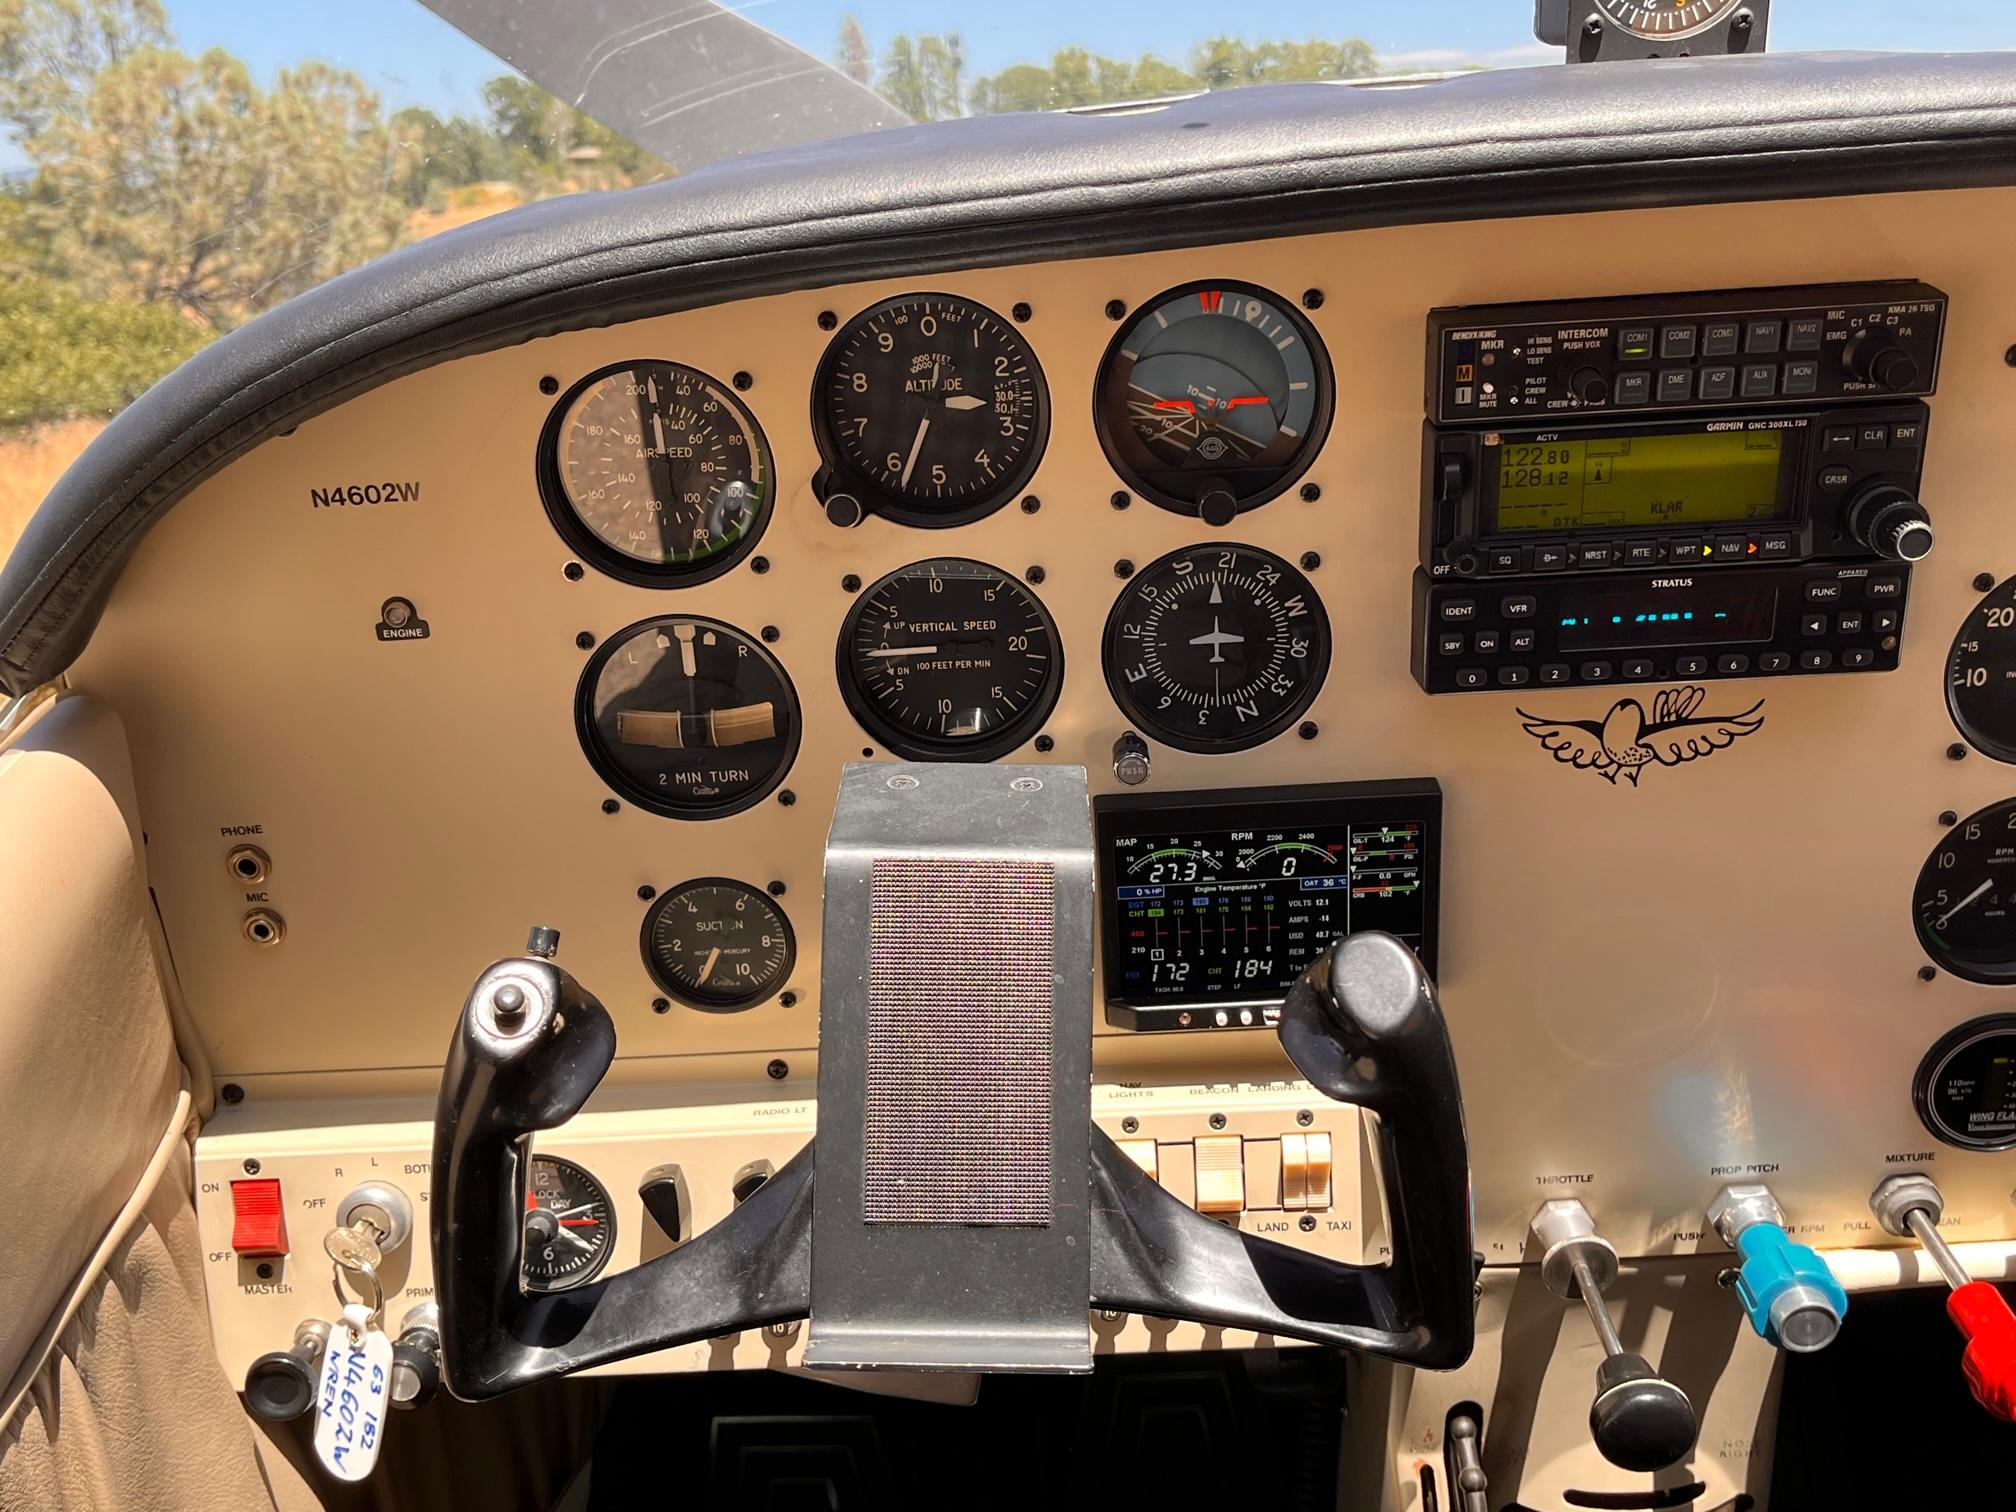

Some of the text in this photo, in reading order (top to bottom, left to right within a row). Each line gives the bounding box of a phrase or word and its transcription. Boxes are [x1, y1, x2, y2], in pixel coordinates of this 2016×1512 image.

[941, 312, 961, 322] FEET
[1827, 311, 1845, 320] MIC
[1558, 328, 1609, 340] INTERCOM
[1756, 326, 1774, 336] NAV1
[1827, 331, 1847, 340] EMG
[878, 333, 893, 352] 9
[1627, 333, 1648, 342] COM1
[1481, 340, 1504, 350] MKR
[1563, 341, 1601, 350] PUSH VOX
[994, 357, 1009, 376] 2
[853, 373, 867, 392] 8
[1525, 377, 1547, 385] PILOT
[1712, 373, 1726, 382] ADF
[626, 385, 645, 395] 200
[906, 378, 963, 392] ALTIDE
[676, 386, 690, 396] 40
[1525, 386, 1547, 395] CREW
[704, 402, 717, 412] 60
[1479, 400, 1497, 408] MUTE
[1547, 400, 1568, 408] CREW
[586, 426, 603, 435] 180
[854, 418, 868, 437] 7
[1000, 417, 1014, 436] 3
[1707, 421, 1744, 432] GARMIN
[1748, 421, 1767, 430] GNC
[689, 434, 702, 444] 60
[1536, 434, 1559, 442] ACTV
[1864, 431, 1883, 440] CLR
[1897, 429, 1916, 439] ENT
[624, 435, 641, 444] 160
[729, 435, 742, 445] 80
[887, 453, 901, 471] 6
[975, 449, 990, 467] 4
[701, 462, 714, 472] 80
[618, 474, 635, 483] 140
[932, 465, 946, 484] 5
[1825, 474, 1848, 484] CRSR
[311, 482, 420, 508] N4602W
[588, 490, 605, 499] 160
[1650, 502, 1683, 514] KLAR
[1721, 544, 1740, 553] NAV
[1765, 540, 1786, 550] MSG
[1585, 551, 1606, 560] NRST
[1632, 549, 1650, 557] RTE
[1676, 546, 1696, 555] WPT
[1219, 552, 1236, 569] 21
[1433, 565, 1450, 575] OFF
[1256, 565, 1282, 586] 24
[929, 579, 943, 593] 10
[1652, 578, 1693, 588] STRATUS
[1812, 587, 1837, 597] FUNC
[1874, 584, 1895, 593] PWR
[984, 590, 996, 601] 15
[1284, 595, 1308, 617] W
[1510, 604, 1527, 613] VFR
[1446, 607, 1472, 616] IDENT
[1986, 607, 2015, 628] 20
[894, 622, 905, 630] UP
[909, 620, 996, 633] VERTICAL SPEED
[1842, 620, 1858, 629] ENT
[383, 628, 423, 638] ENGINE
[1123, 623, 1141, 639] 12
[1008, 636, 1028, 651] 20
[1445, 641, 1460, 650] SBY
[1480, 640, 1494, 648] ON
[1515, 638, 1530, 647] ALT
[1968, 641, 1978, 652] 15
[738, 646, 747, 657] R
[932, 661, 952, 670] FEET
[974, 660, 991, 668] MIN
[1125, 663, 1148, 683] E
[1966, 668, 1987, 687] 10
[1271, 674, 1294, 696] 33
[991, 687, 1002, 698] 15
[938, 699, 952, 713] 10
[1236, 700, 1260, 722] N
[659, 770, 749, 785] 2 MIN TURN
[221, 824, 263, 837] PHONE
[1965, 823, 1981, 840] 15
[1231, 832, 1253, 841] RPM
[1116, 838, 1137, 847] MAP
[1995, 848, 2014, 856] RPM
[1938, 852, 1955, 869] 10
[1282, 857, 1296, 876] 0
[1150, 862, 1197, 883] 27.3
[246, 892, 269, 902] MIC
[1936, 890, 1948, 905] 5
[688, 902, 698, 912] 4
[736, 899, 745, 910] 6
[696, 920, 743, 931] SUCTN
[673, 939, 682, 951] 2
[762, 936, 771, 947] 8
[736, 963, 750, 975] 10
[1152, 963, 1190, 982] 172
[1234, 960, 1272, 978] 184
[1190, 1087, 1239, 1095] BEACON
[753, 1108, 790, 1116] RADIO
[1970, 1112, 1995, 1122] WING
[1885, 1152, 1935, 1163] MIXTURE
[1711, 1164, 1779, 1175] PROP PITCH
[535, 1173, 549, 1186] 12
[1536, 1174, 1594, 1185] THROTTLE
[201, 1183, 219, 1193] ON
[303, 1199, 326, 1209] OFF
[551, 1200, 572, 1209] DAY
[1257, 1222, 1289, 1232] LAND
[1326, 1221, 1352, 1231] TAXI
[1844, 1221, 1871, 1231] PULL
[1673, 1232, 1706, 1241] PUSH
[209, 1252, 232, 1262] OFF
[543, 1247, 554, 1260] 6
[245, 1284, 292, 1295] MASTER
[321, 1350, 341, 1418] WREN
[371, 1364, 384, 1395] 63
